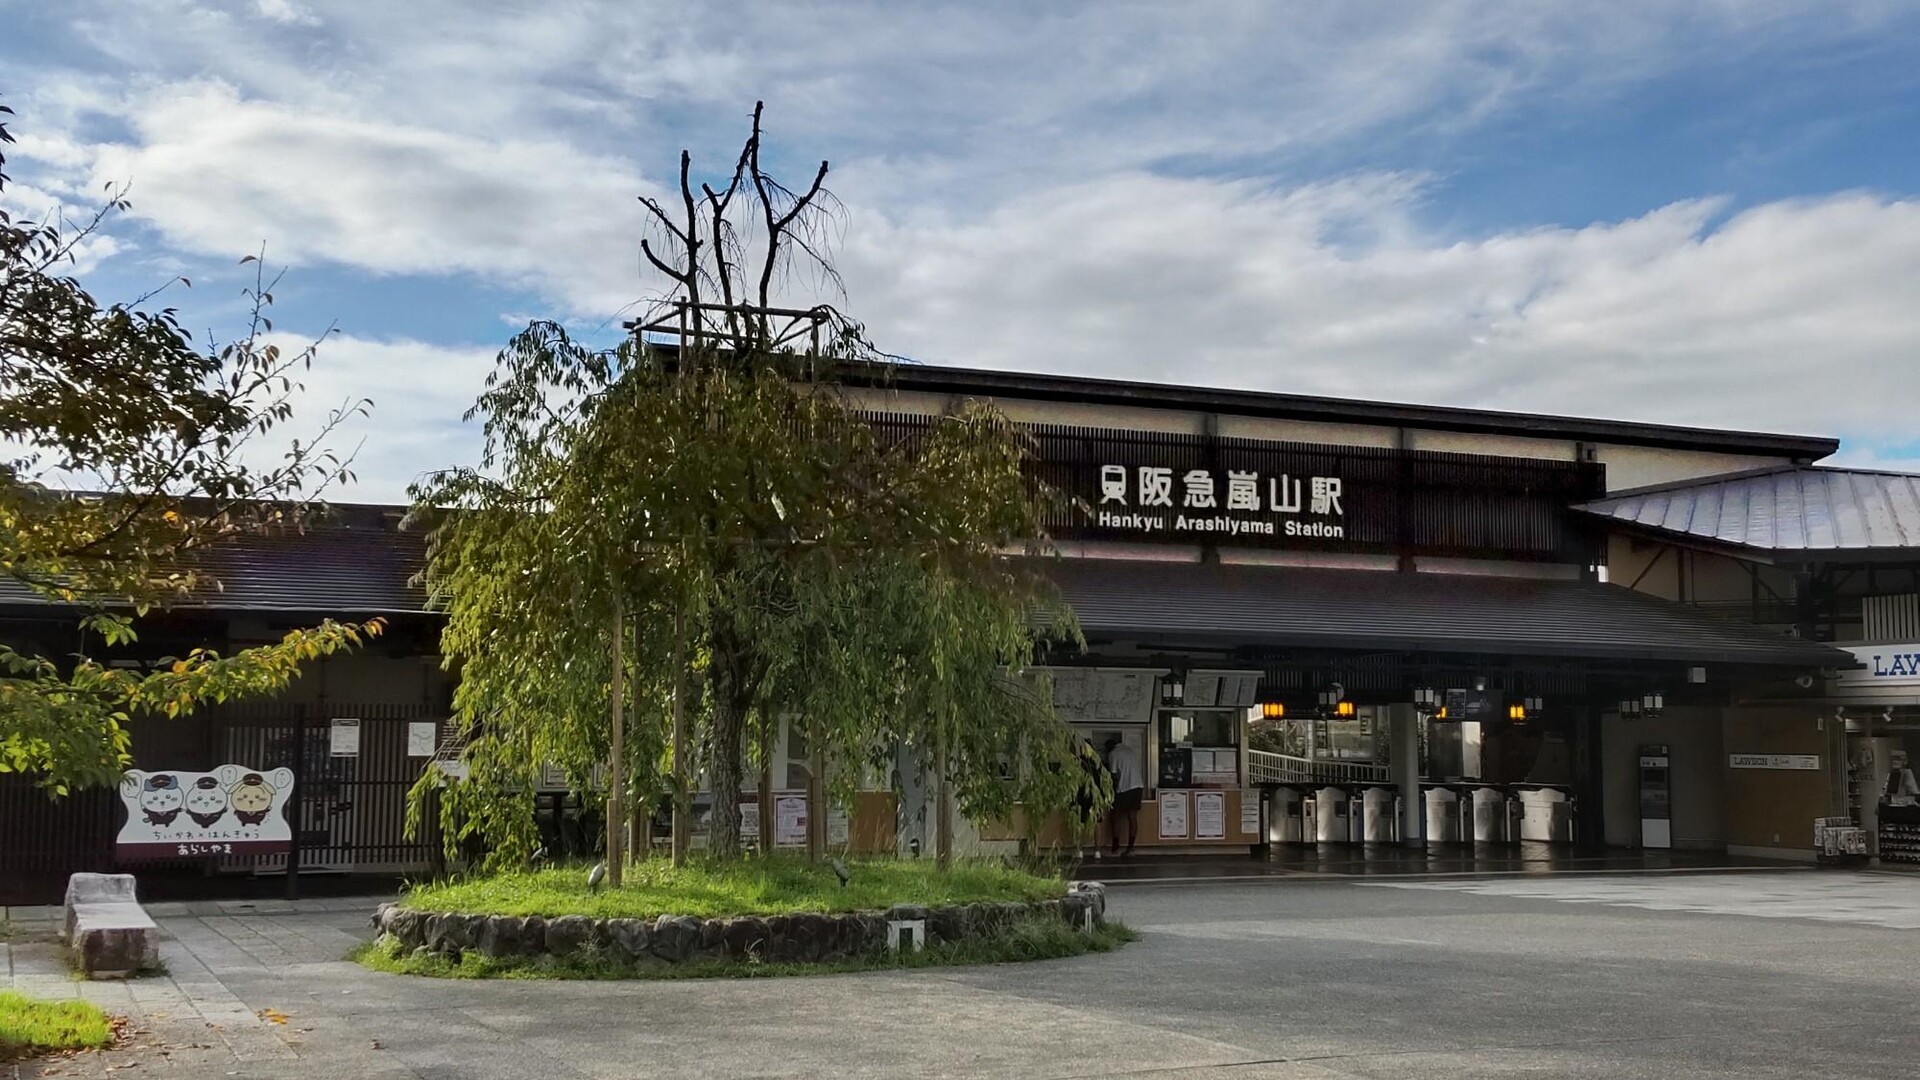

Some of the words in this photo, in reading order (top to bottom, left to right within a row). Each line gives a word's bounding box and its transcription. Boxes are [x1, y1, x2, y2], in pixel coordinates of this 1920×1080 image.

[1138, 466, 1344, 516] 阪急嵐山駅
[1099, 511, 1164, 532] Hankyu
[1175, 515, 1275, 536] Arashiyama
[1285, 520, 1344, 539] Station
[177, 842, 233, 856] あらしやま
